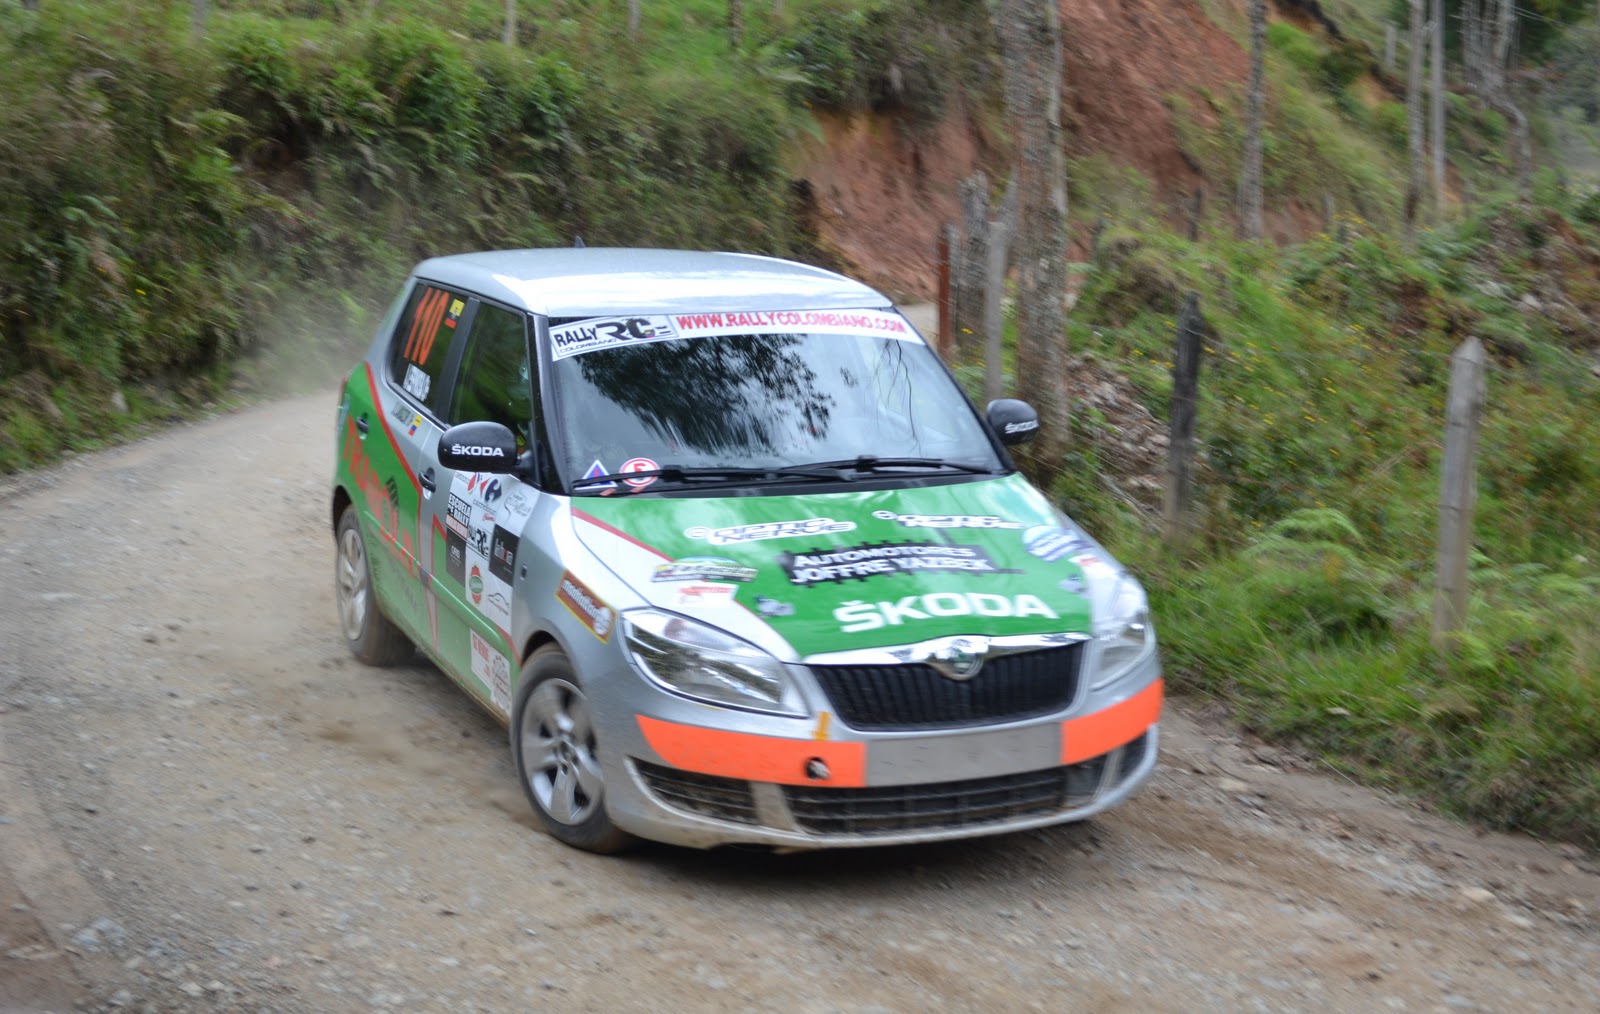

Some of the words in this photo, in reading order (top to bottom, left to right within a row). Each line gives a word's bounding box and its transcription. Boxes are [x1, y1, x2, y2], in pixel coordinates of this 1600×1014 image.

[403, 287, 449, 365] 110
[553, 327, 598, 347] RALLY
[452, 444, 504, 457] ŠKODA
[794, 546, 977, 567] AUTOMOTORES
[791, 559, 896, 583] JOFFRE
[833, 592, 1059, 633] ŠKODA
